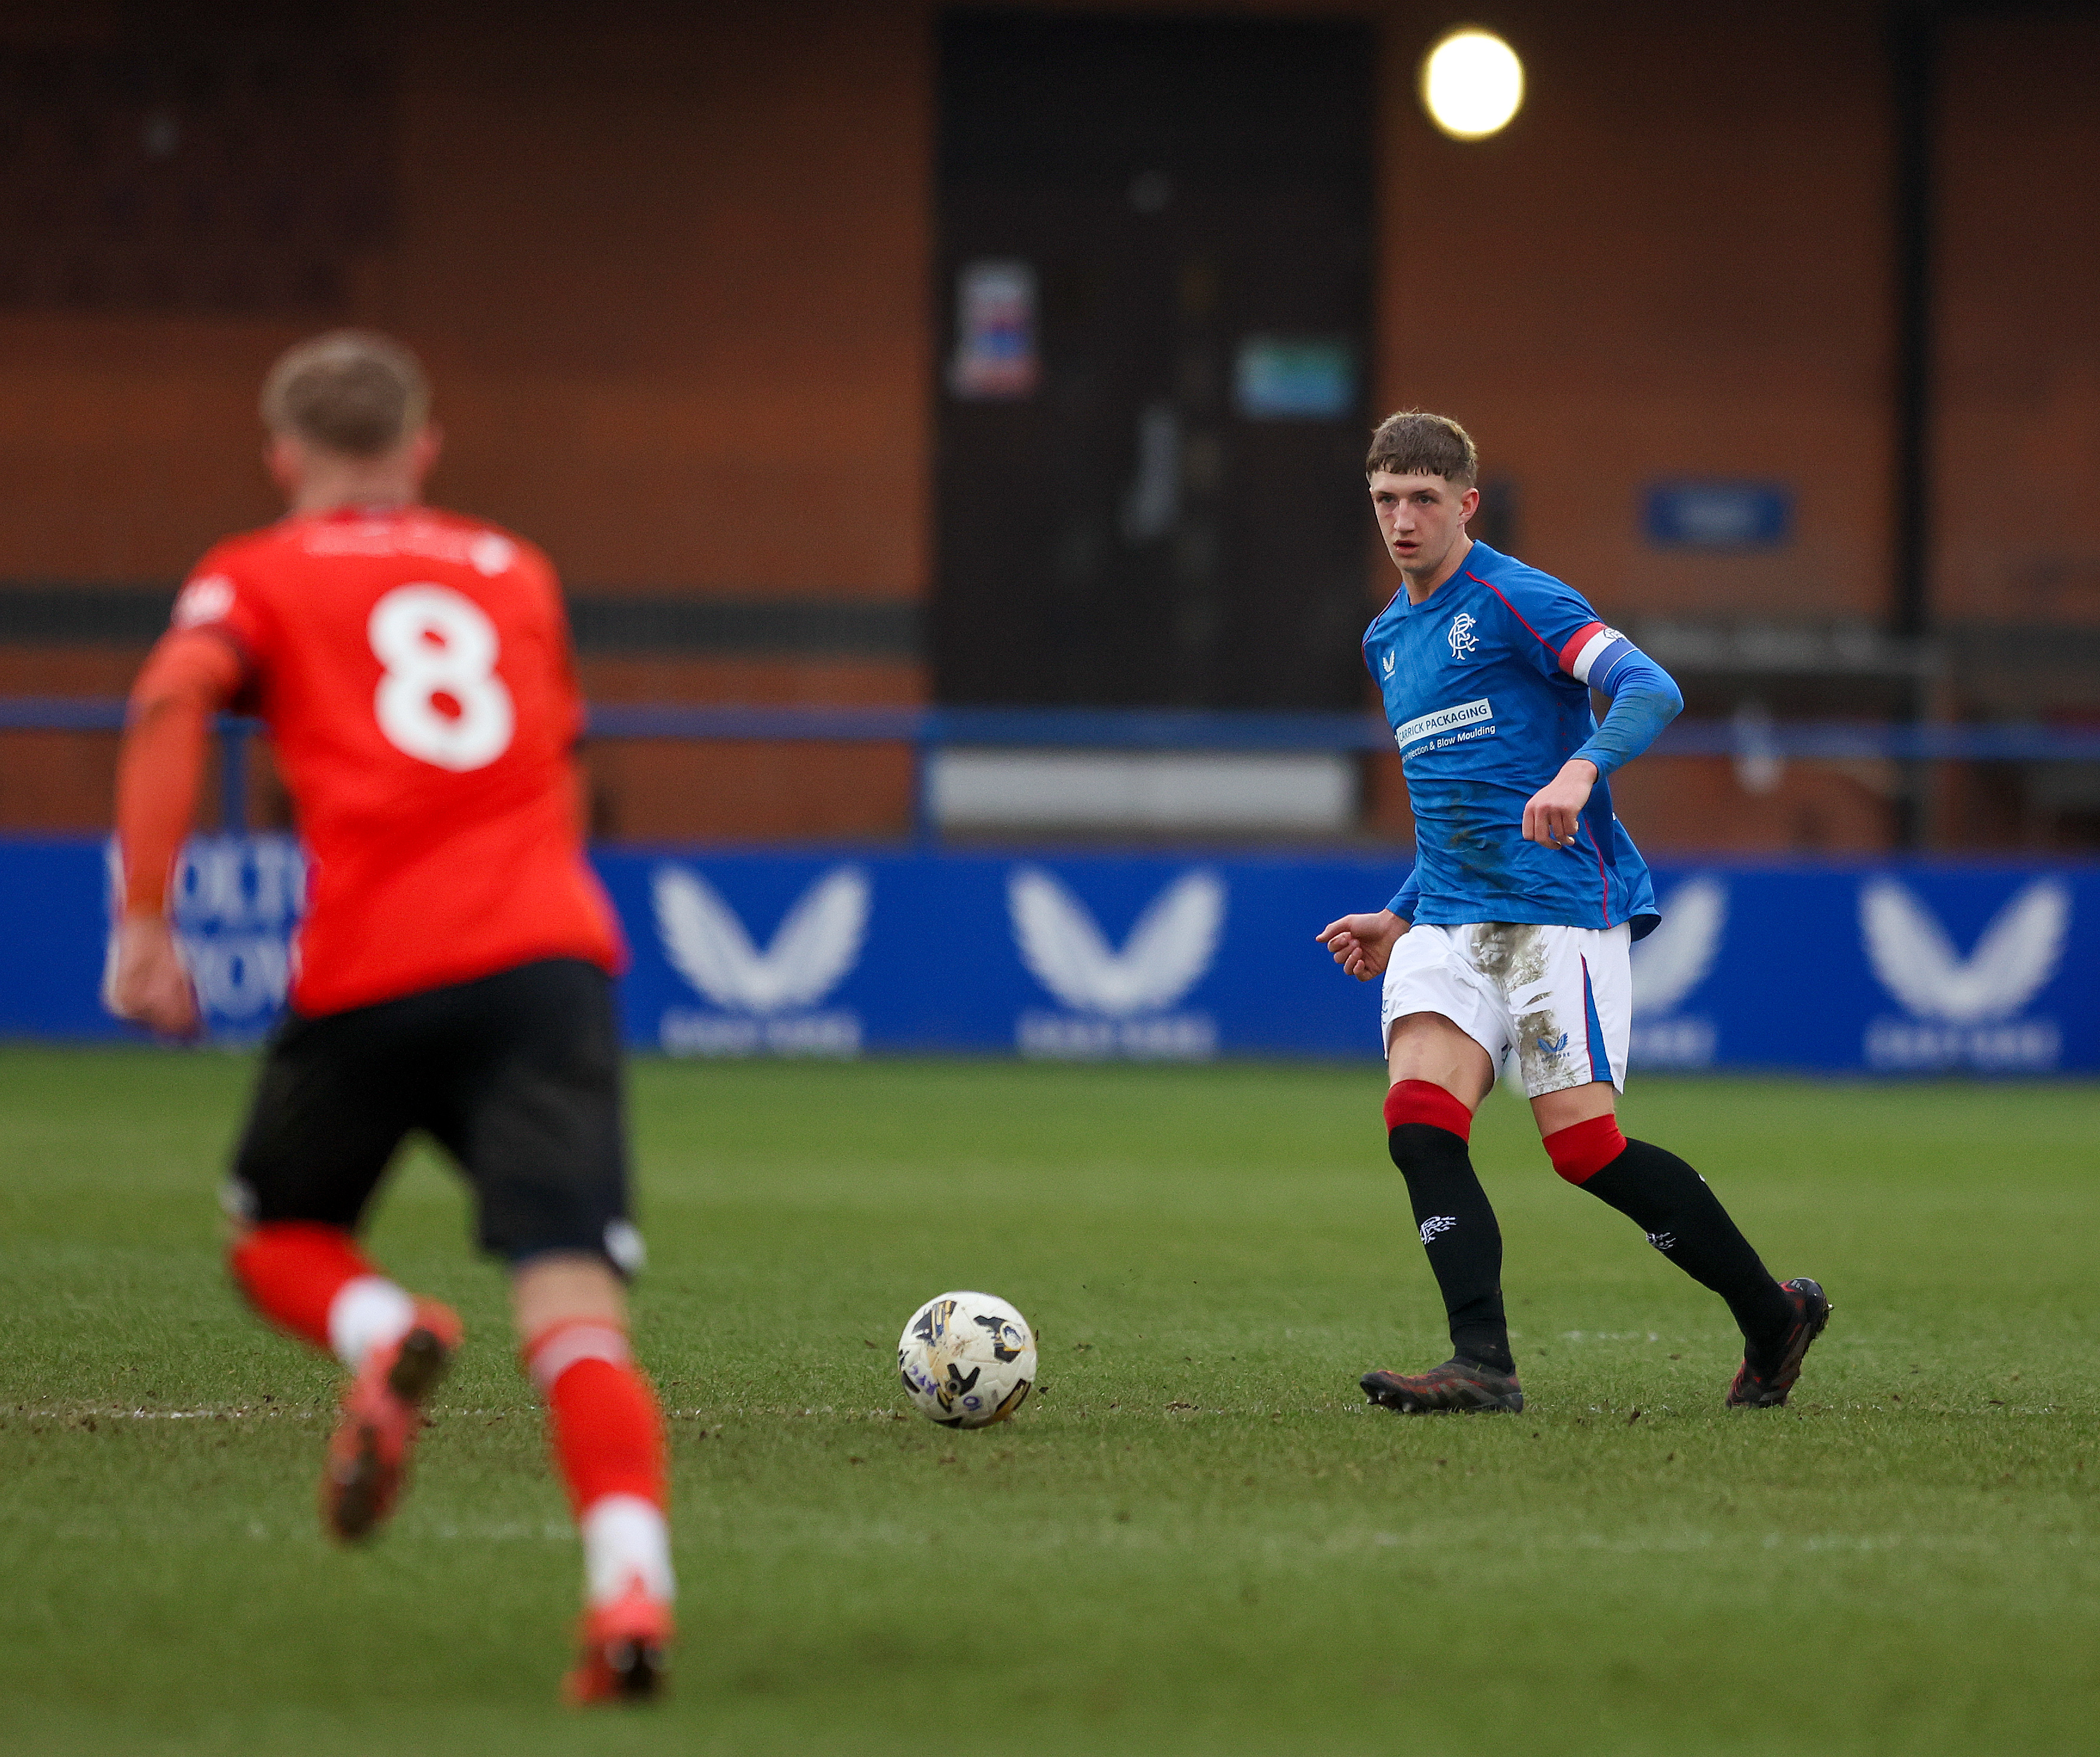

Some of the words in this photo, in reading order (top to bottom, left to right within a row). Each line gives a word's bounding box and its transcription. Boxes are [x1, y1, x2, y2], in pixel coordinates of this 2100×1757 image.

[365, 581, 517, 772] 8
[1398, 722, 1425, 742] CARRICK
[1425, 704, 1488, 731] PACKAGING
[1429, 741, 1436, 750] &
[1437, 736, 1456, 749] Blow
[1457, 725, 1497, 743] Moulding
